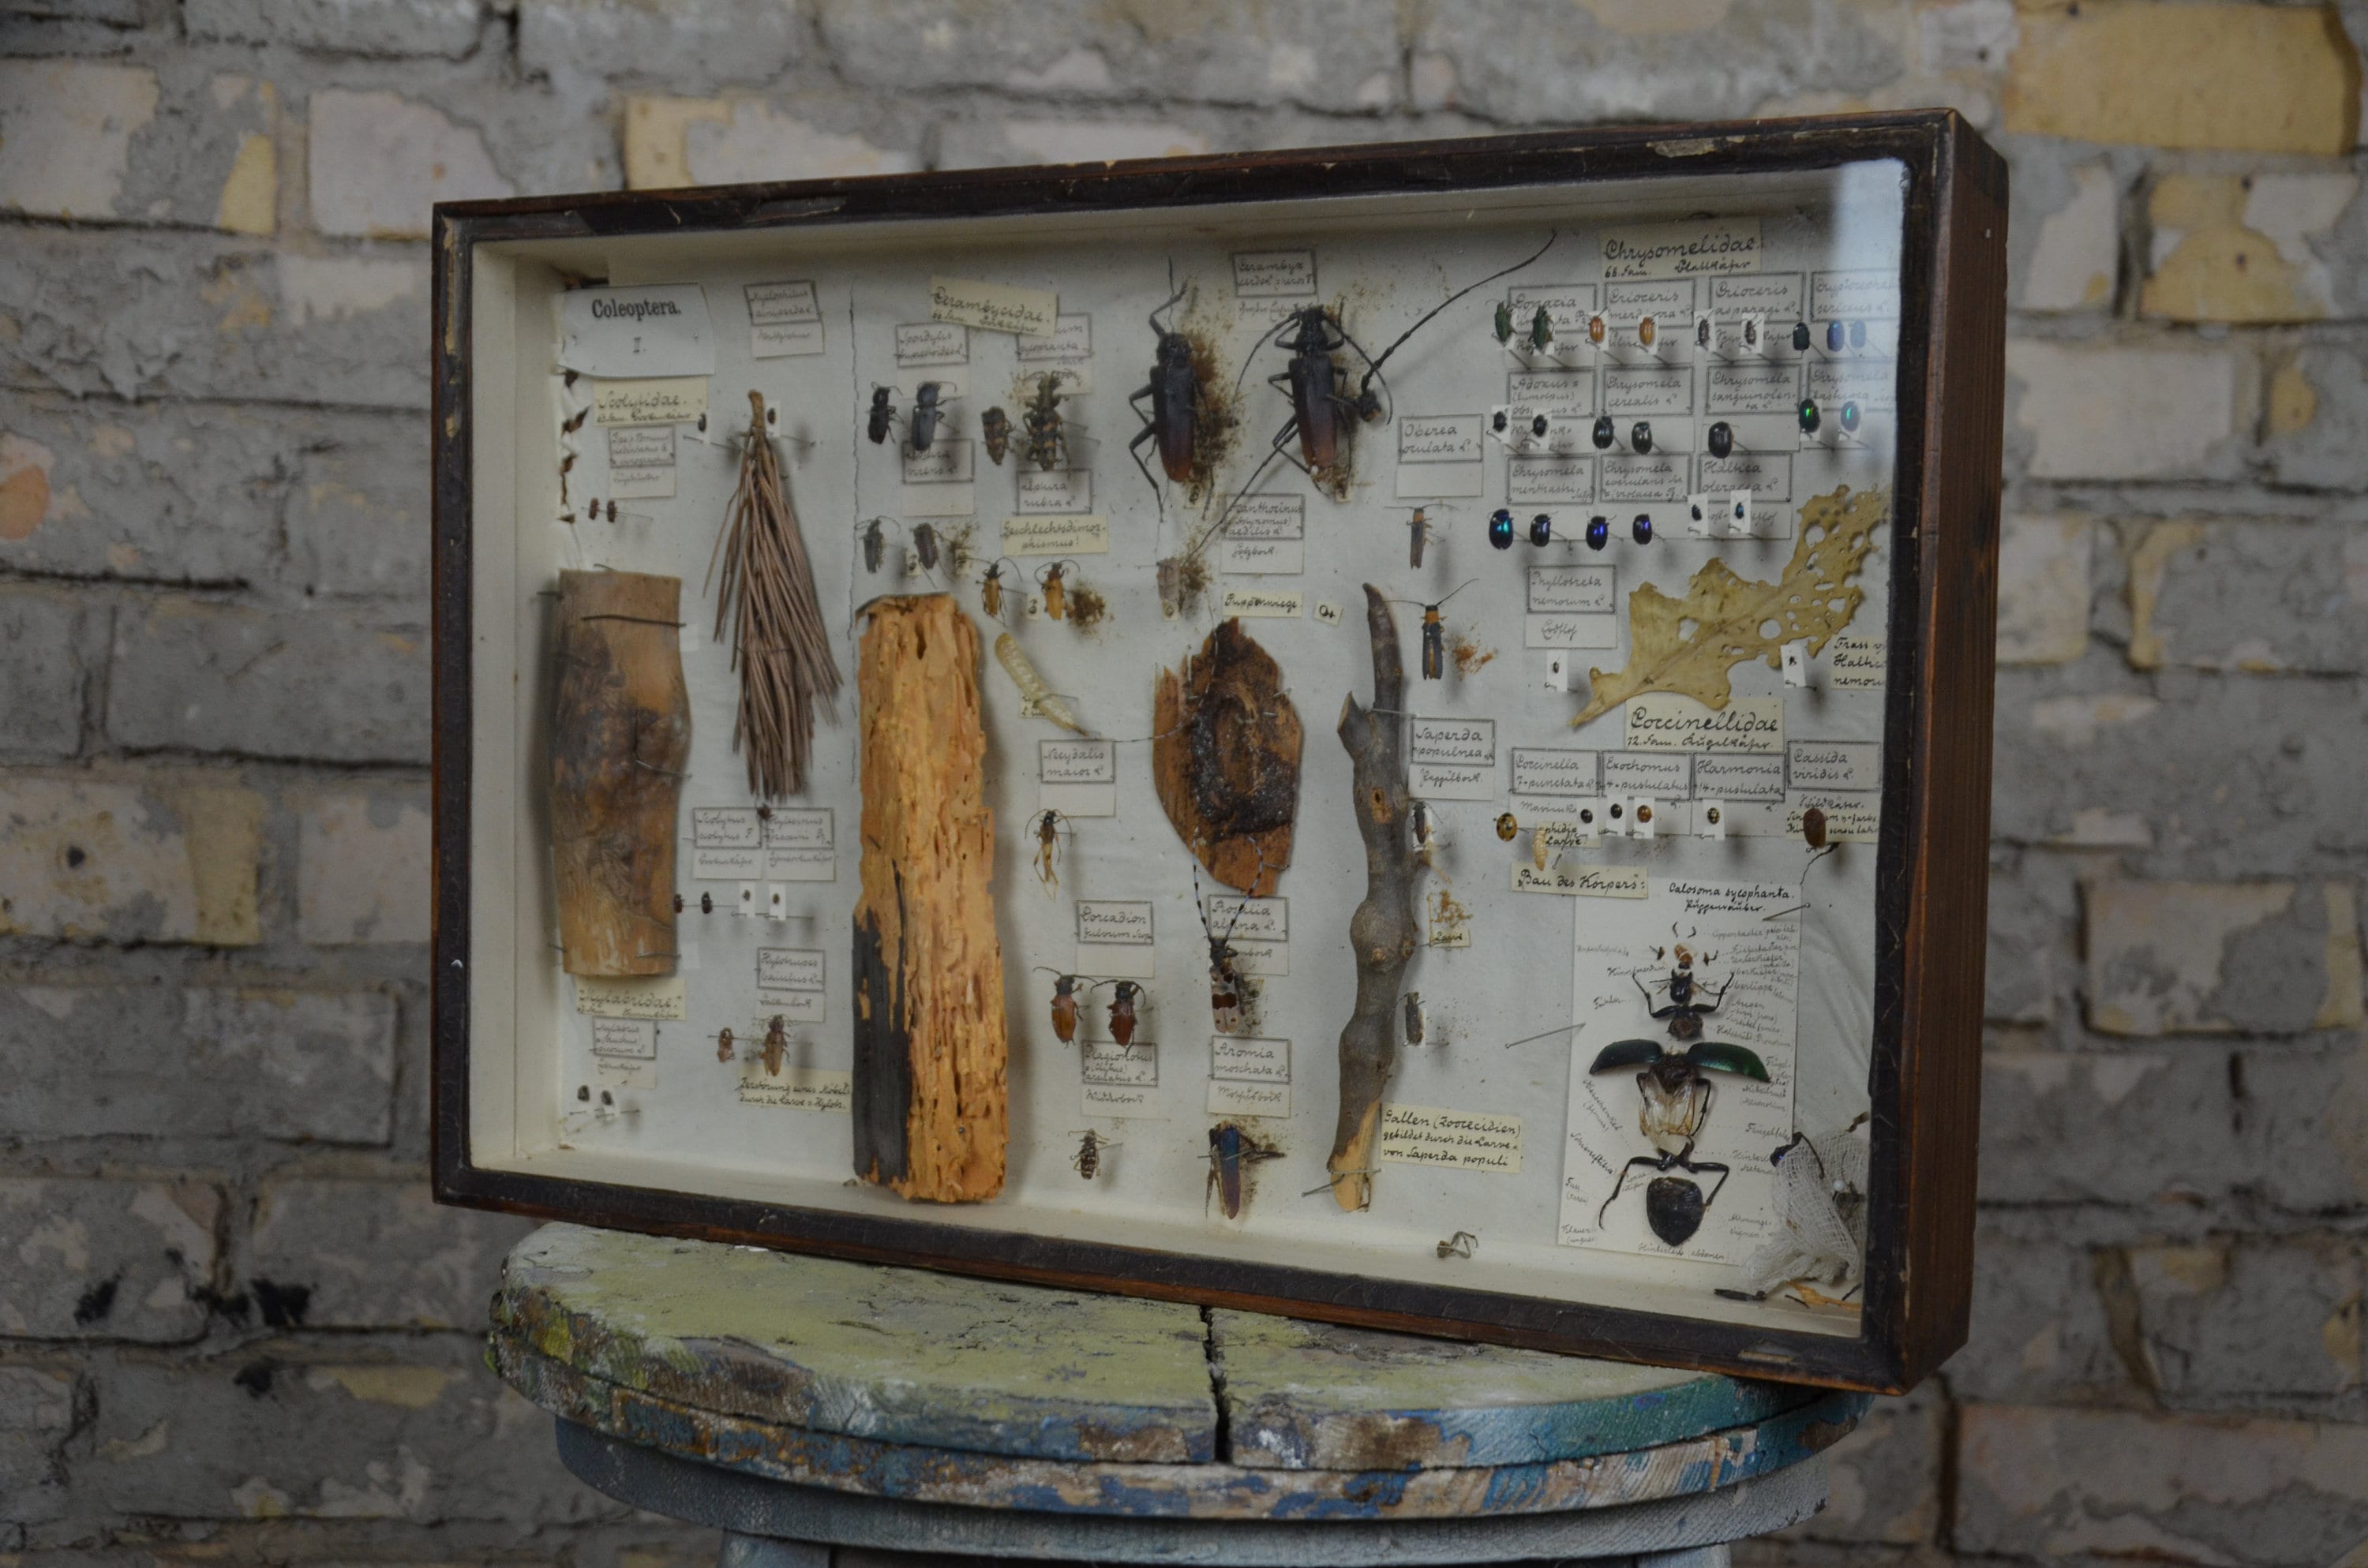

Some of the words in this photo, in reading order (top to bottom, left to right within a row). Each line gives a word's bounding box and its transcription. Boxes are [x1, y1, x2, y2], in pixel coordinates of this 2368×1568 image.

[592, 298, 682, 321] Coleoptera.
[1404, 423, 1458, 438] Oberea
[1630, 705, 1778, 734] Coccinellidae
[1415, 727, 1484, 743] Saperda
[1516, 753, 1579, 770] Coccinella
[1518, 868, 1553, 889] Bau
[1557, 874, 1576, 889] des
[1669, 881, 1722, 896] Calosoma
[1384, 1109, 1429, 1126] Gallen
[1383, 1147, 1403, 1157] von
[1407, 1146, 1459, 1163] Saperda
[1463, 1154, 1509, 1169] populi
